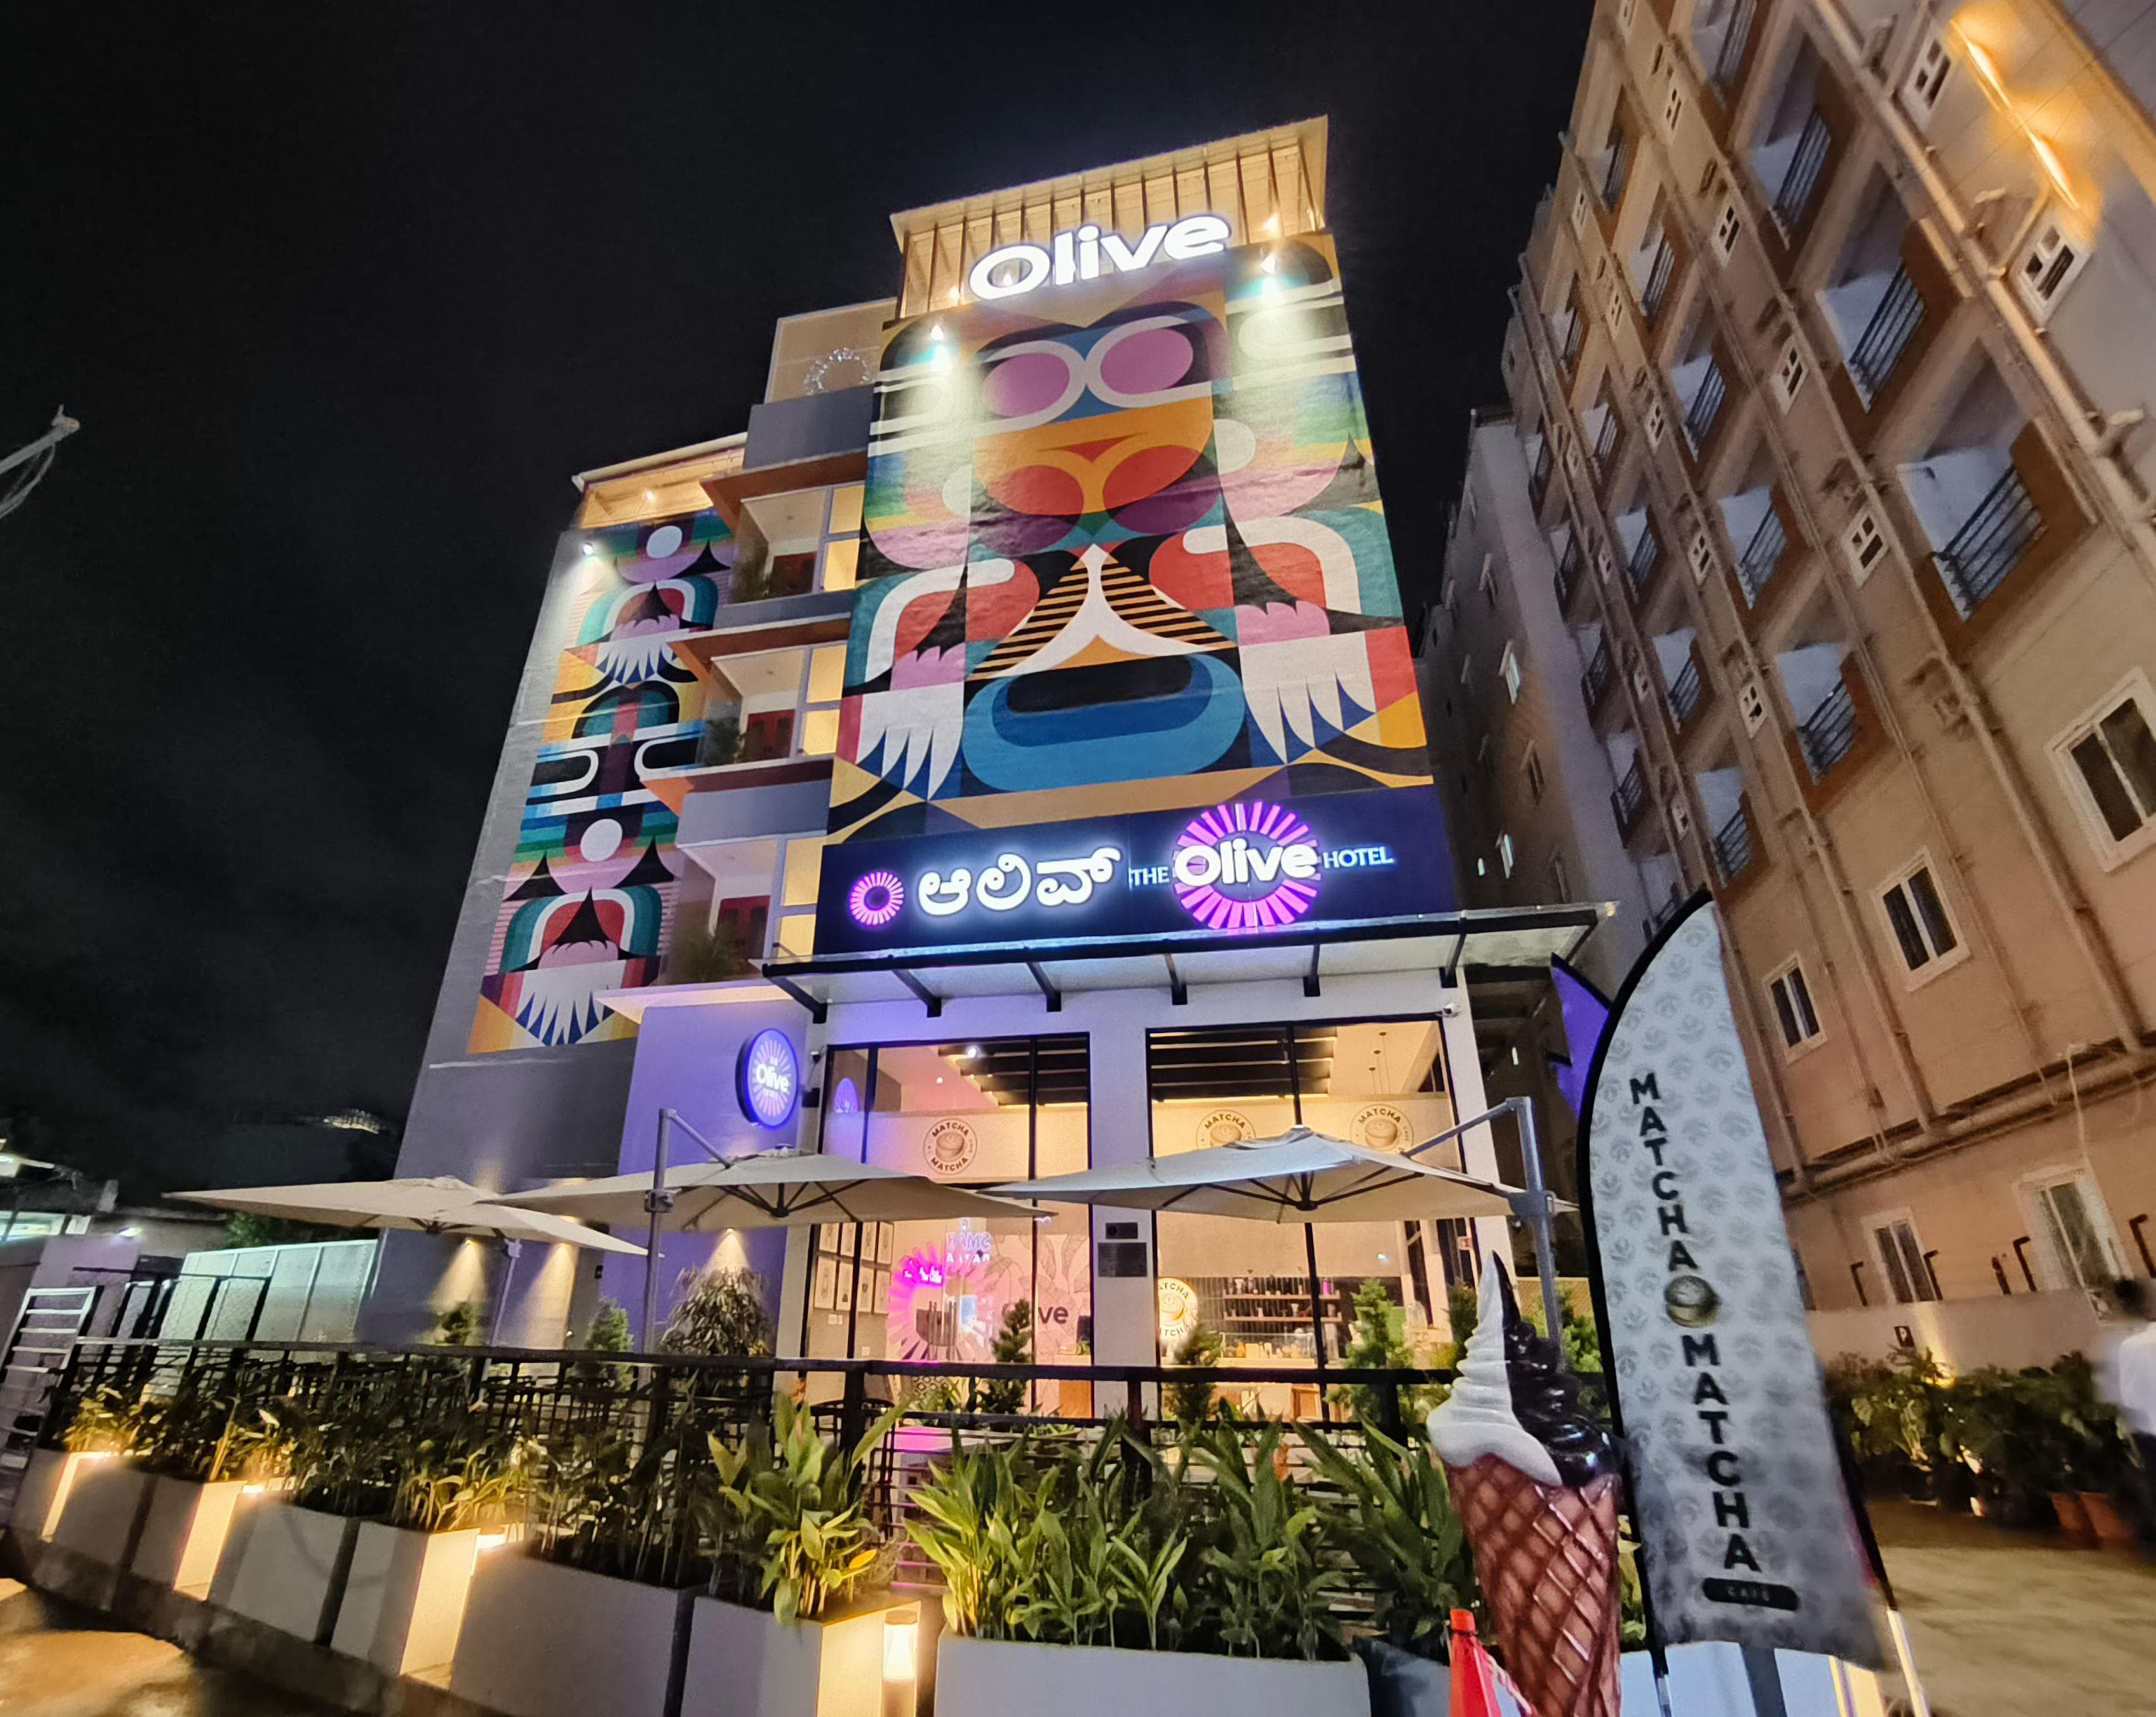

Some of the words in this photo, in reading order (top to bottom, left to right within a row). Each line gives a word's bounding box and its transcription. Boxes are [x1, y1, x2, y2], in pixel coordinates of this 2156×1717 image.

[969, 215, 1229, 300] Olive
[1131, 866, 1170, 886] THE
[1174, 838, 1318, 887] Olive
[1323, 846, 1394, 868] HOTEL
[918, 847, 1121, 916] ಆಲಿವ್
[756, 1063, 789, 1093] Olive
[931, 1122, 969, 1136] MATCHA
[1204, 1114, 1245, 1129] MATCHA
[1358, 1108, 1401, 1124] MATCHA
[931, 1157, 968, 1171] MATCHA
[1629, 1072, 1698, 1272] MATCHA
[1681, 1333, 1763, 1573] MATCHA
